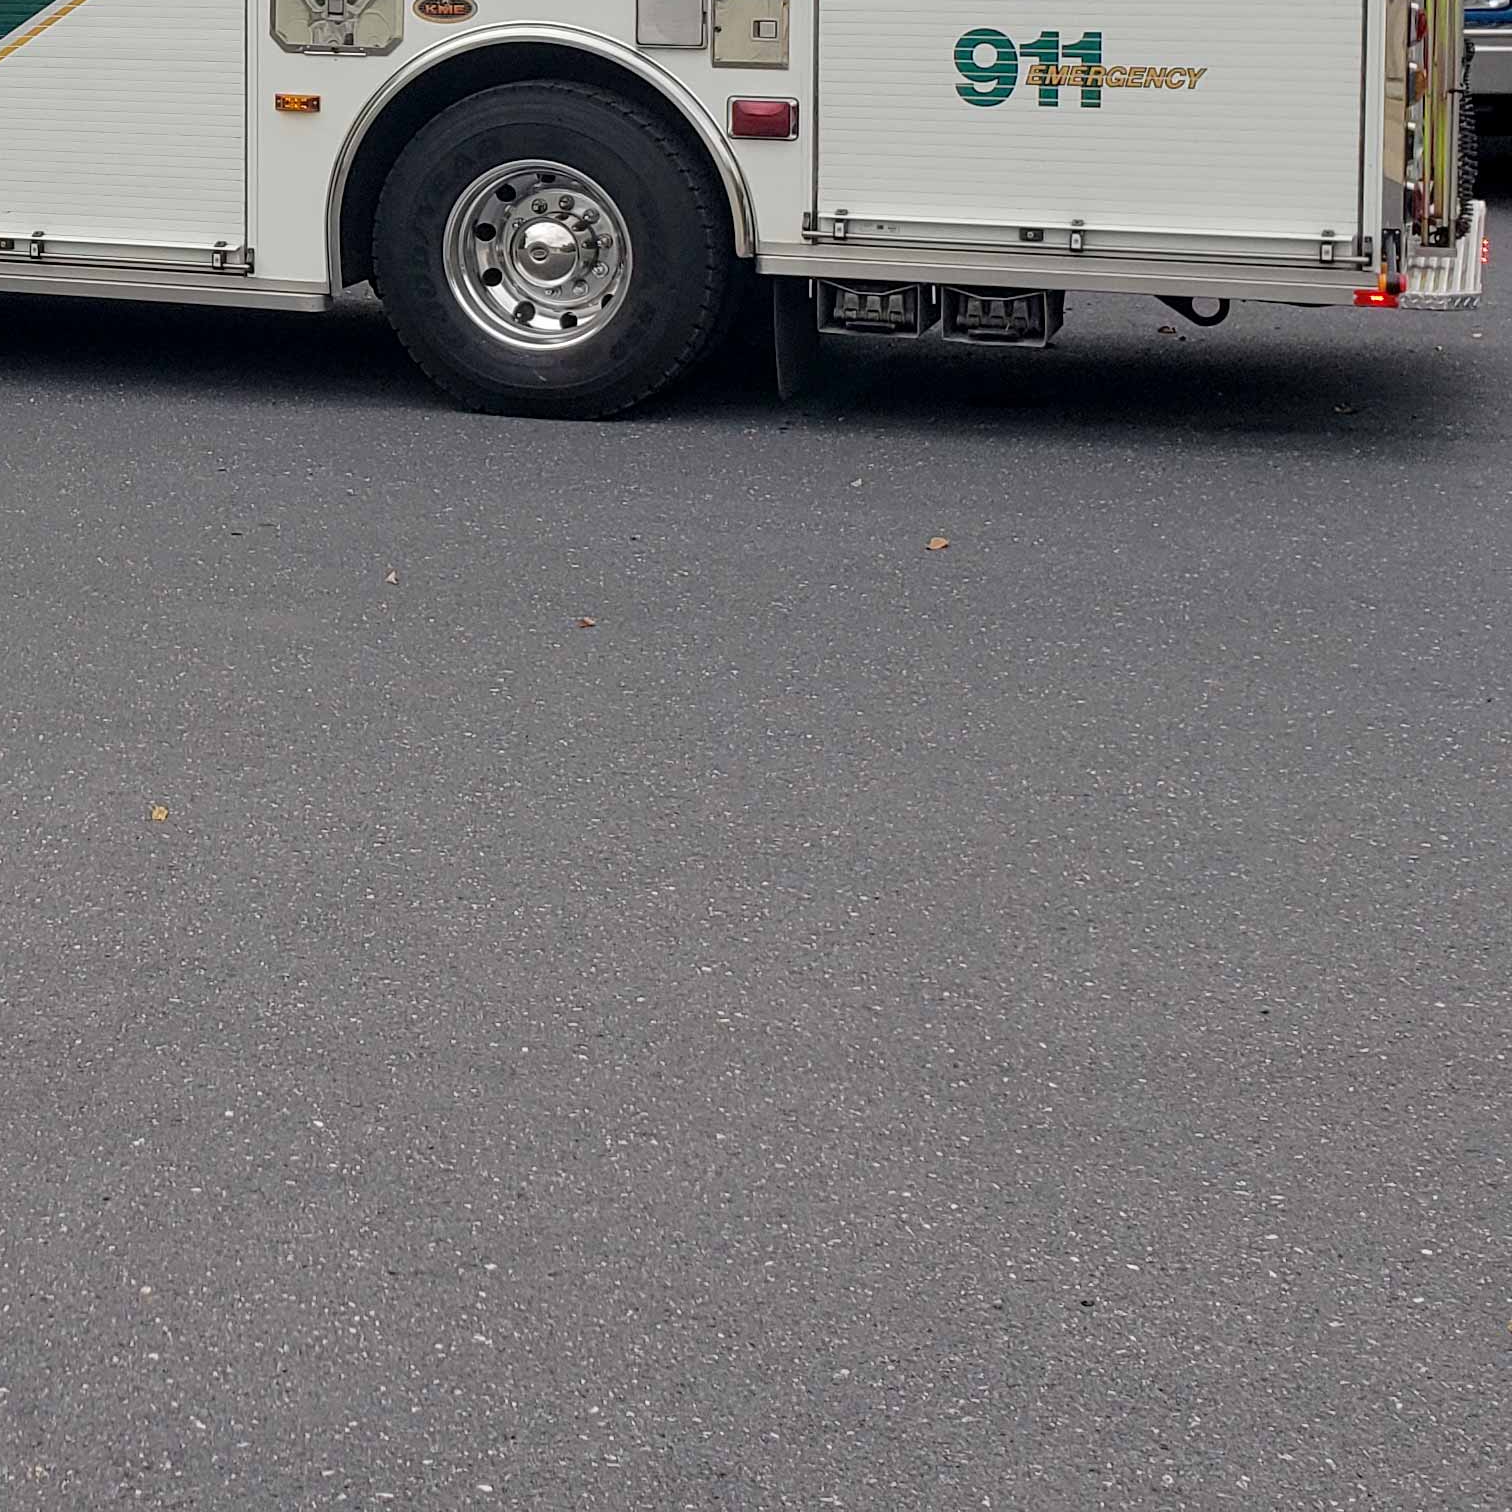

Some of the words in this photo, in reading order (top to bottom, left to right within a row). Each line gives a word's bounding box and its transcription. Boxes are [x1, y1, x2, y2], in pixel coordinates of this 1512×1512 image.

[424, 4, 466, 15] KME
[953, 28, 1102, 108] 911
[1025, 65, 1207, 90] EMERGENCY
